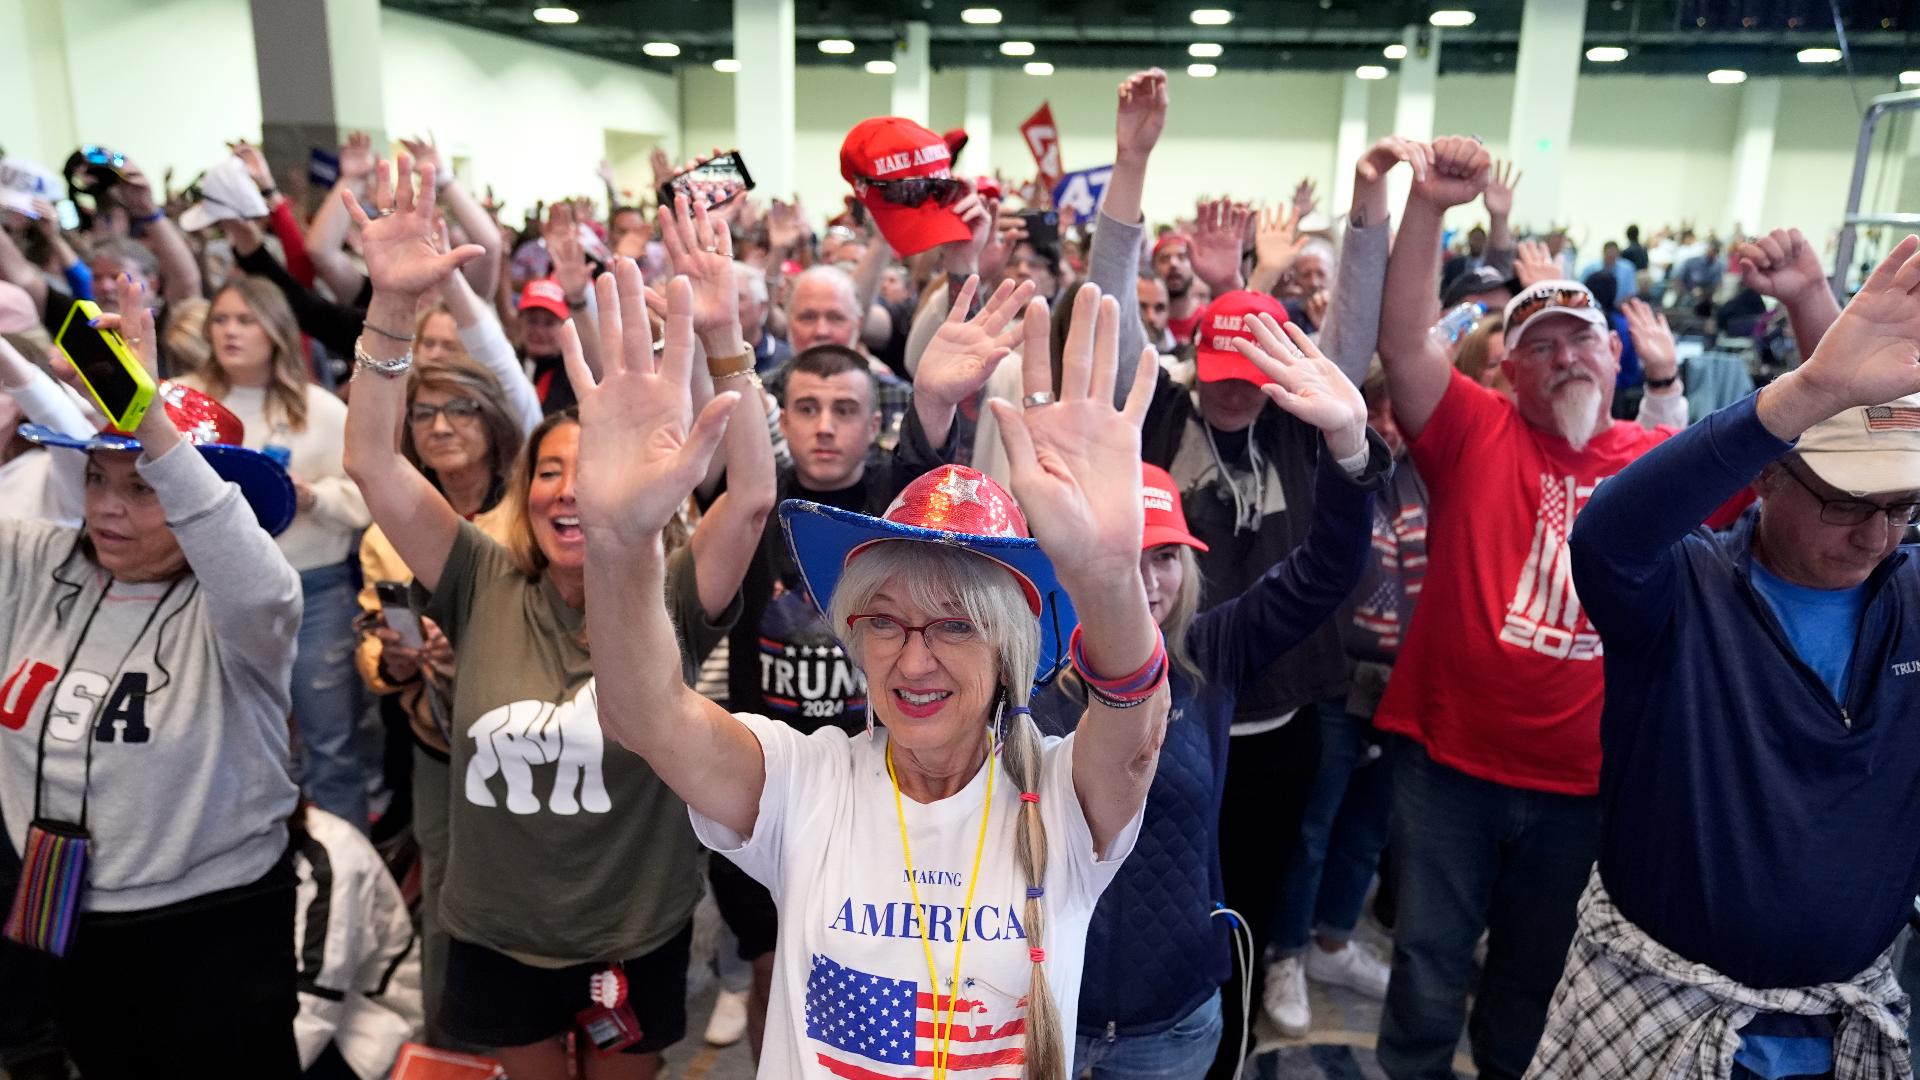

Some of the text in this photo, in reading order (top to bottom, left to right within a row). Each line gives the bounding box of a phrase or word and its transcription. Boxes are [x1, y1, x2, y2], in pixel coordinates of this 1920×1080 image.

[874, 153, 912, 176] MAKE
[1058, 169, 1114, 218] 47
[759, 652, 868, 700] TRUM
[1891, 660, 1920, 676] TRU
[0, 658, 150, 743] USA
[903, 869, 962, 887] MAKING
[828, 897, 1028, 943] AMERICA
